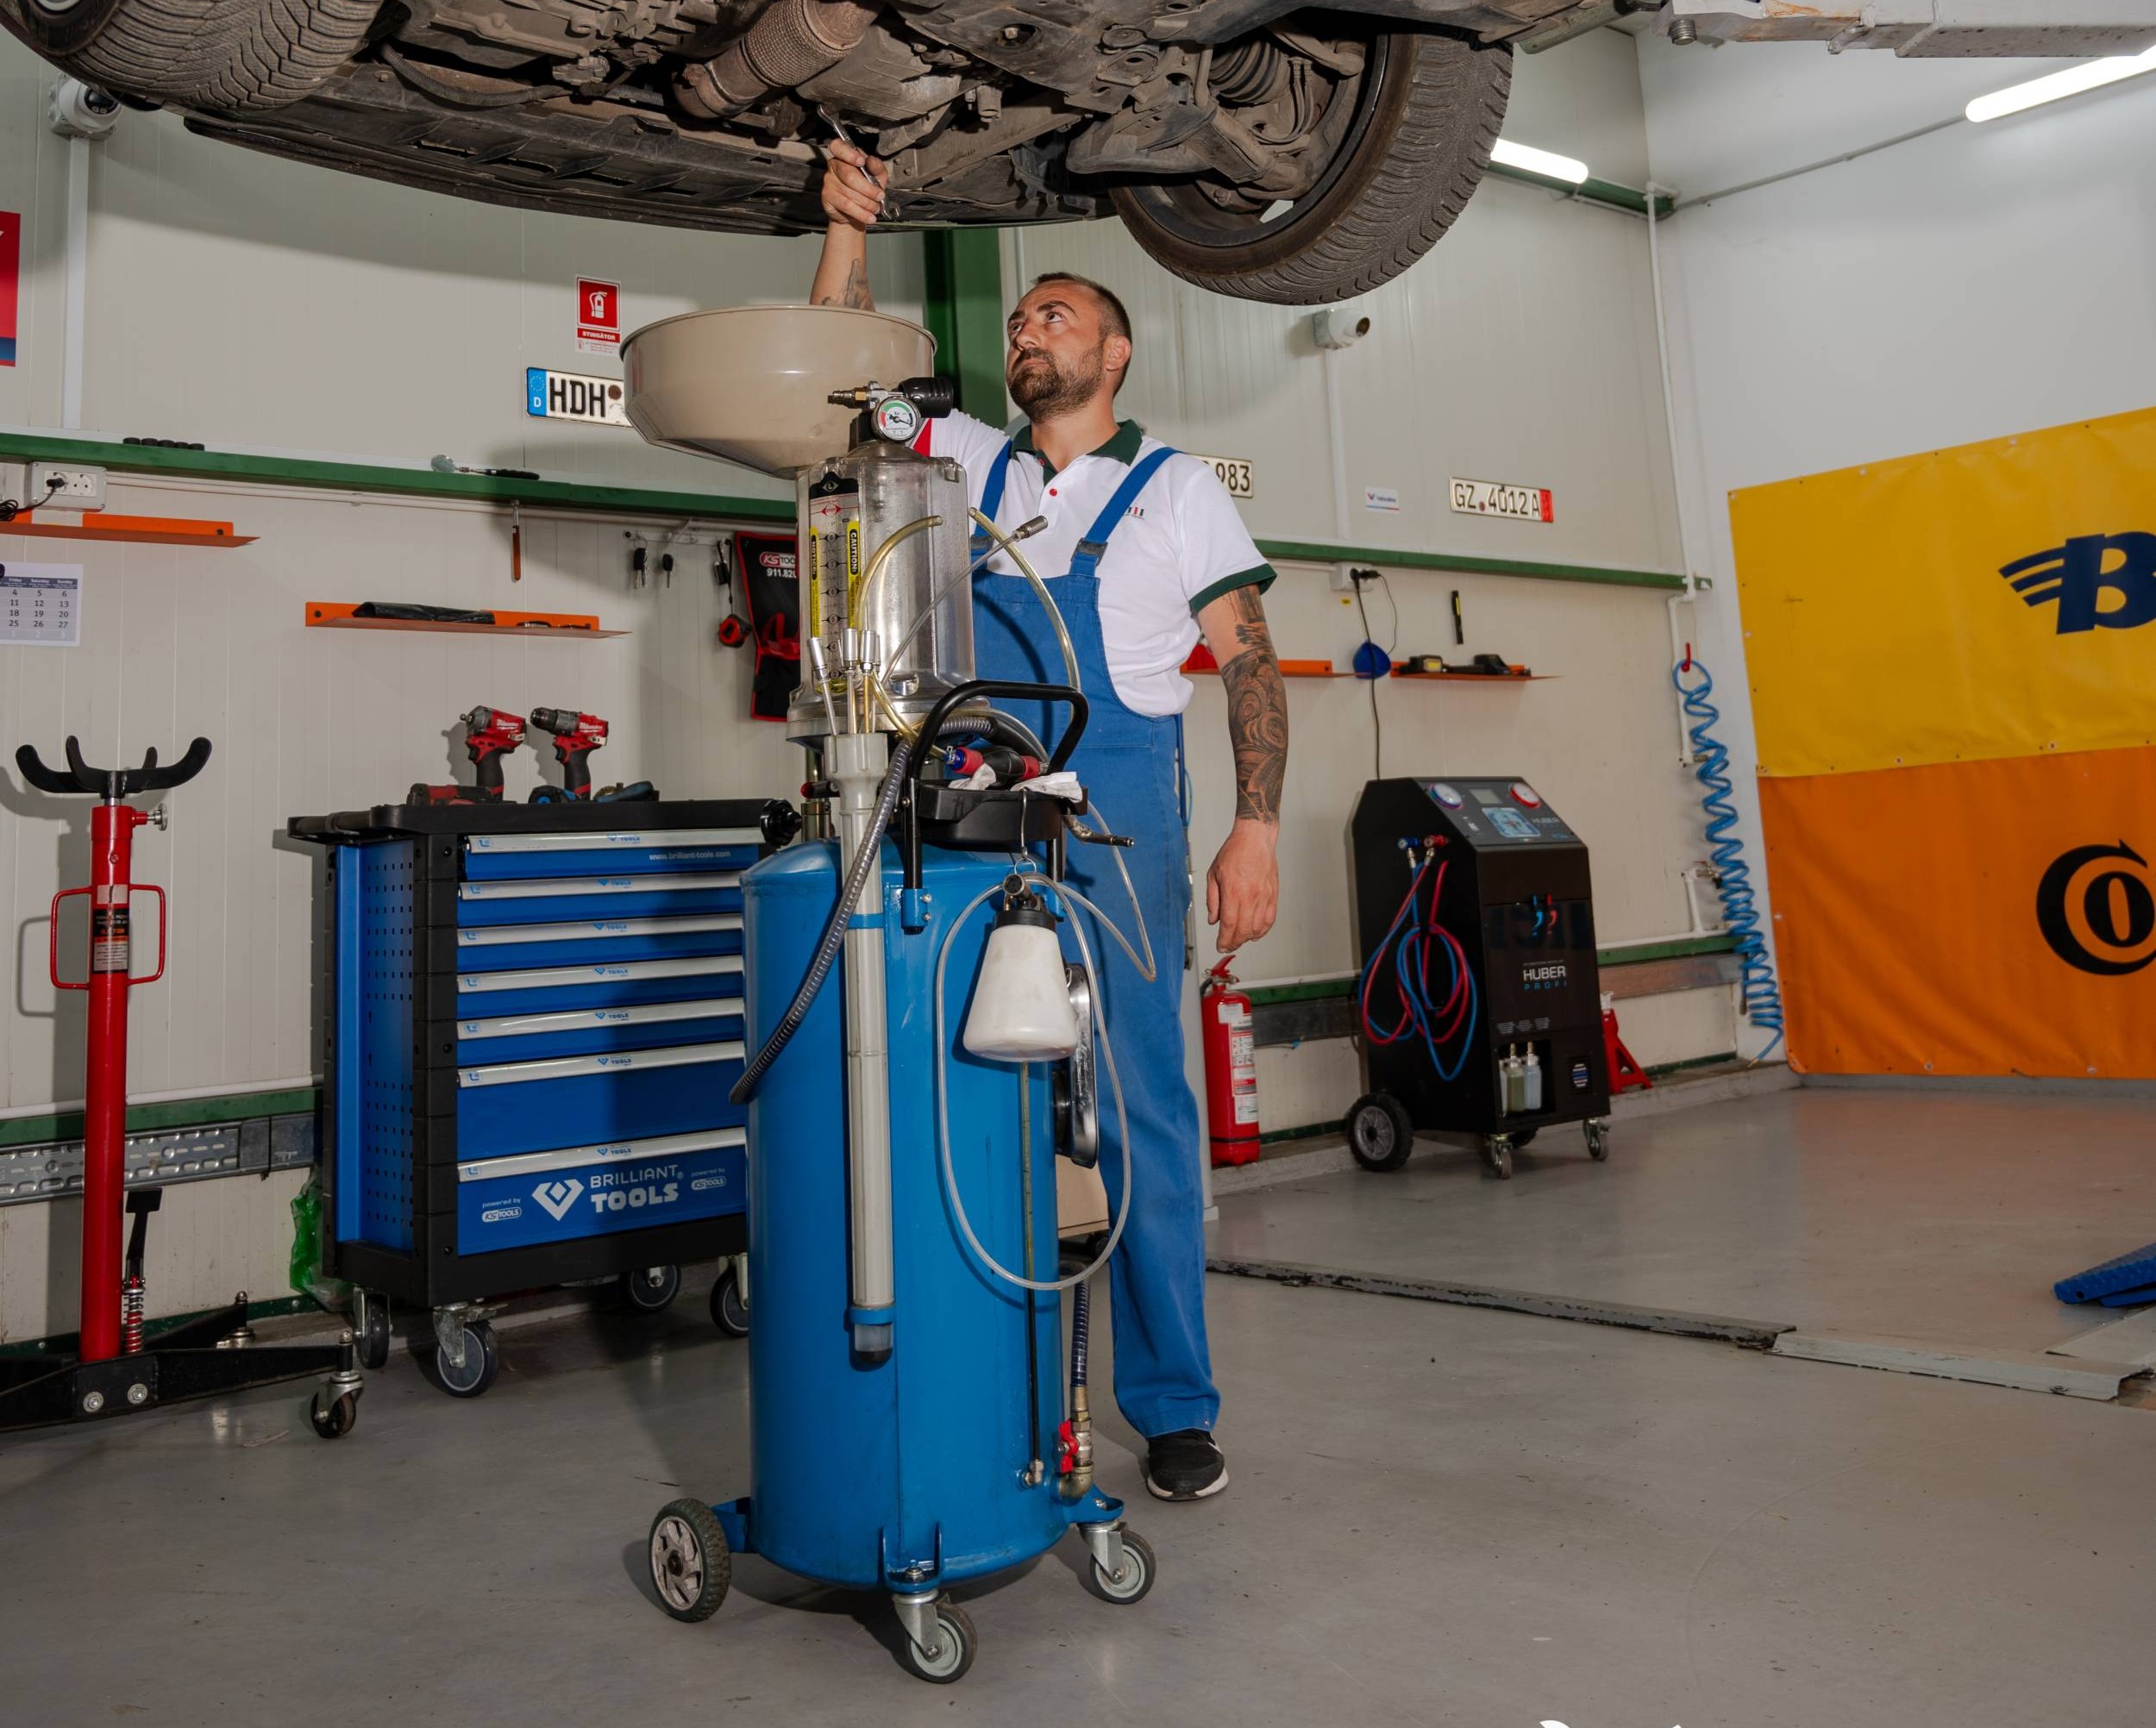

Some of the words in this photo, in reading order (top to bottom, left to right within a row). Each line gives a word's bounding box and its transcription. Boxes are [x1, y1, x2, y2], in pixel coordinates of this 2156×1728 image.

[534, 397, 542, 408] D
[549, 377, 605, 417] HDH
[1454, 484, 1476, 509] GZ
[1523, 966, 1566, 981] HUBER
[483, 1199, 511, 1209] powered
[591, 1183, 679, 1213] TOOLS
